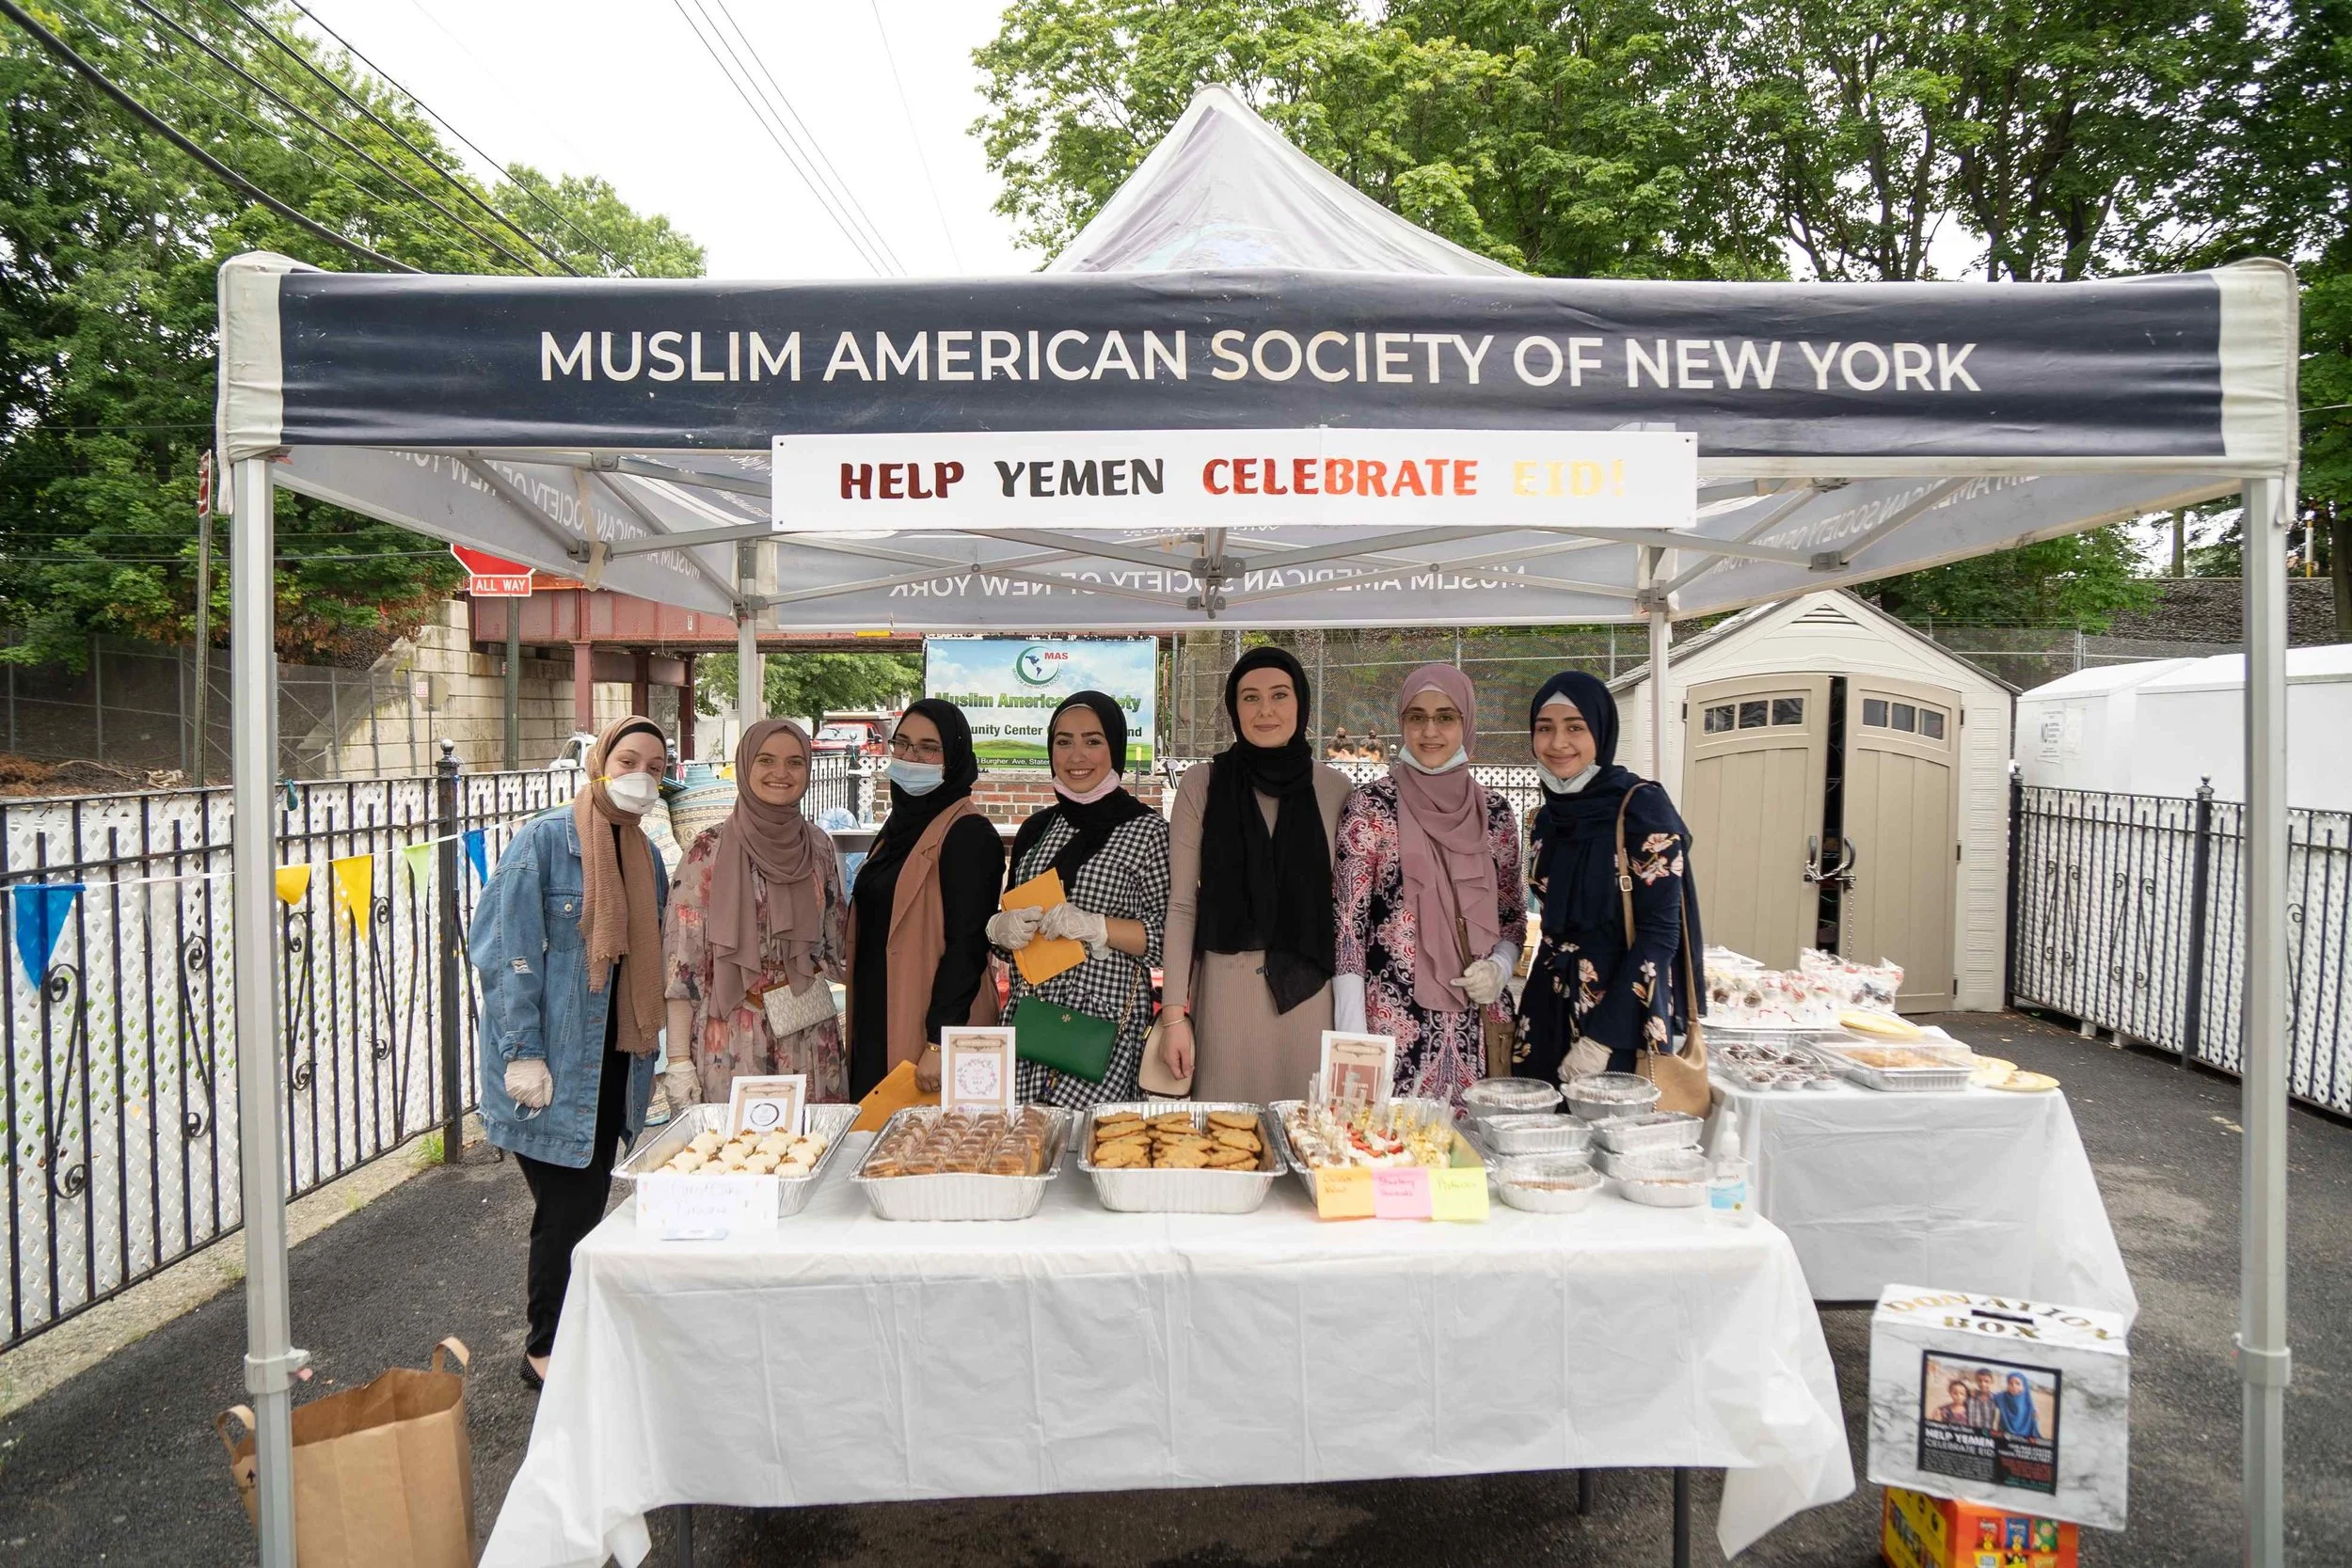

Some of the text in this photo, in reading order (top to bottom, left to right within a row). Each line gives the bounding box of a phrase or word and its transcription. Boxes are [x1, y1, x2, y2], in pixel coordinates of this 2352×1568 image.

[541, 329, 1982, 392] MUSLIM AMERICAN SOCIETY OF NEW YORK
[840, 457, 1624, 500] HELP YEMEN CELEBRATE EID!
[475, 578, 526, 592] ALL WAY
[1044, 652, 1069, 660] MAS
[996, 692, 1068, 709] America
[1004, 724, 1043, 736] Center
[980, 757, 1009, 766] Burgher
[1943, 1315, 2040, 1339] BOX
[1925, 1428, 1954, 1443] HELP
[1955, 1433, 1995, 1449] YEMEN
